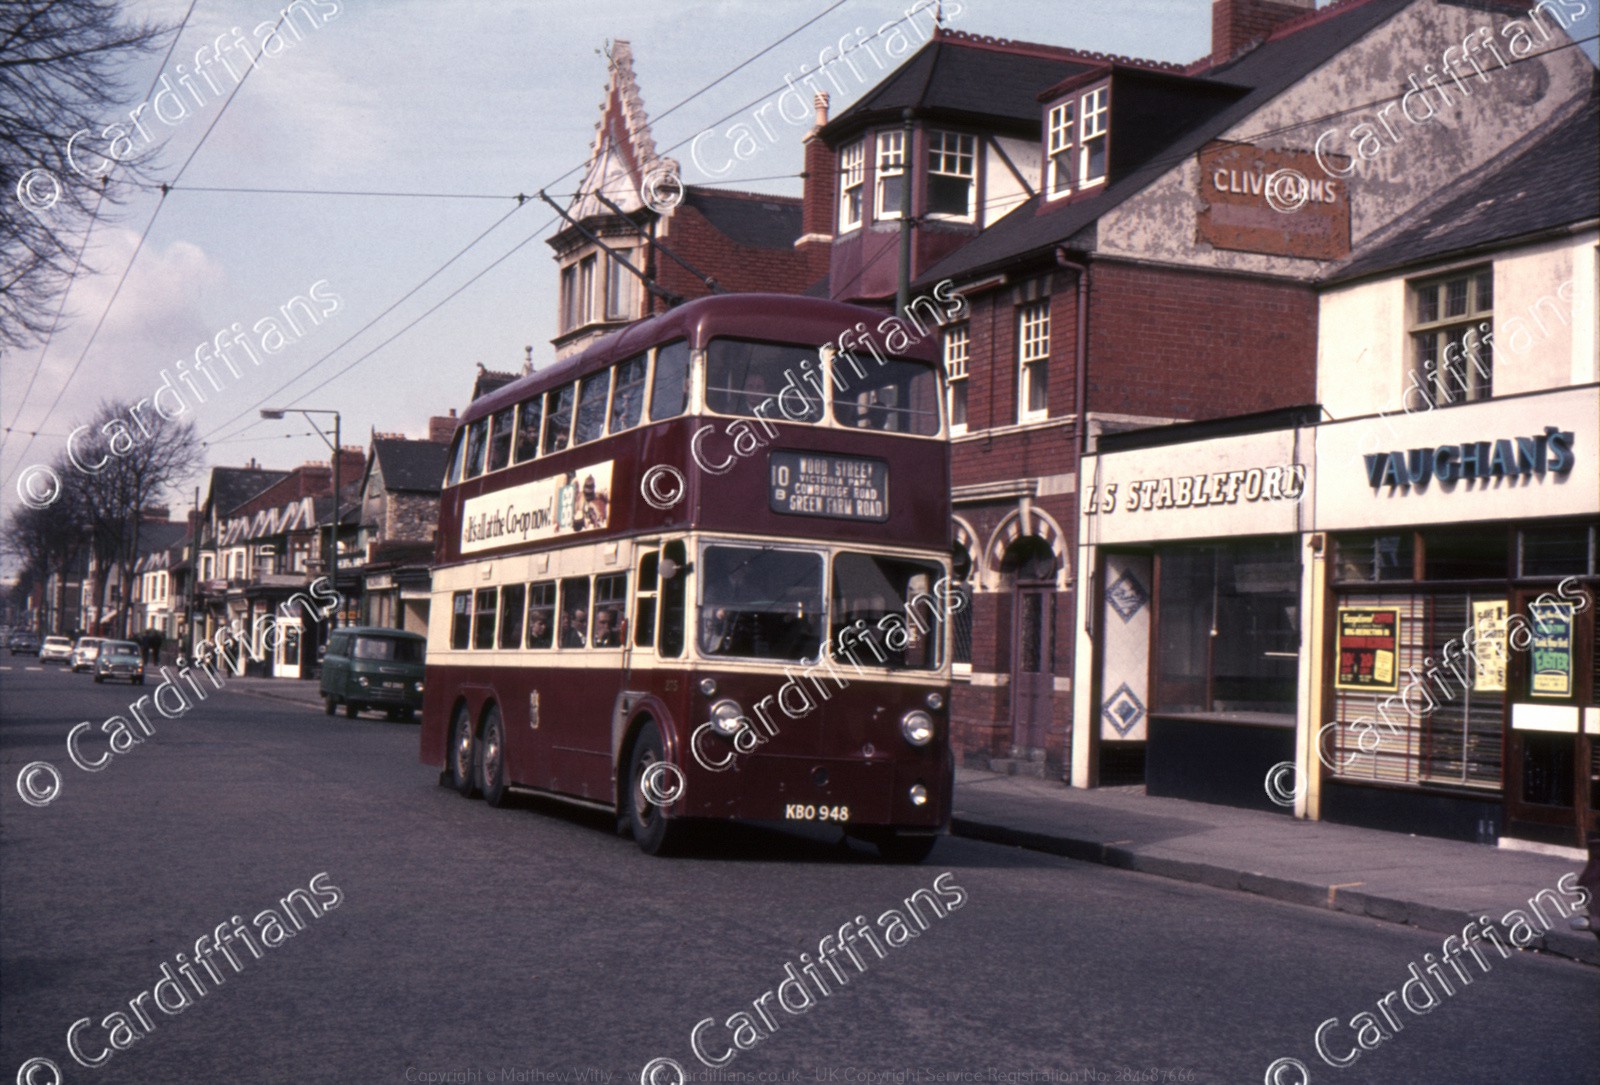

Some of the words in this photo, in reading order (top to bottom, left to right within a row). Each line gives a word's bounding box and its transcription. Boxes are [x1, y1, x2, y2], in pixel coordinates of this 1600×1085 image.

[1213, 168, 1276, 198] CLIVE
[1283, 176, 1336, 203] ARMS
[800, 457, 828, 475] WOOD
[835, 462, 873, 478] STREET
[1363, 426, 1575, 490] VAUGHAN'S
[771, 465, 790, 487] 10
[800, 474, 843, 486] VICTORIA
[848, 478, 872, 488] PARK
[775, 488, 786, 500] B
[794, 482, 848, 497] COWBRIDGE
[854, 487, 878, 500] ROAD
[1126, 464, 1306, 512] STABLEFORD
[790, 494, 822, 512] GREEN
[826, 498, 852, 514] FARM
[856, 500, 882, 517] ROAD
[506, 504, 531, 540] Co-op
[786, 804, 816, 820] KBO
[819, 805, 848, 821] 948
